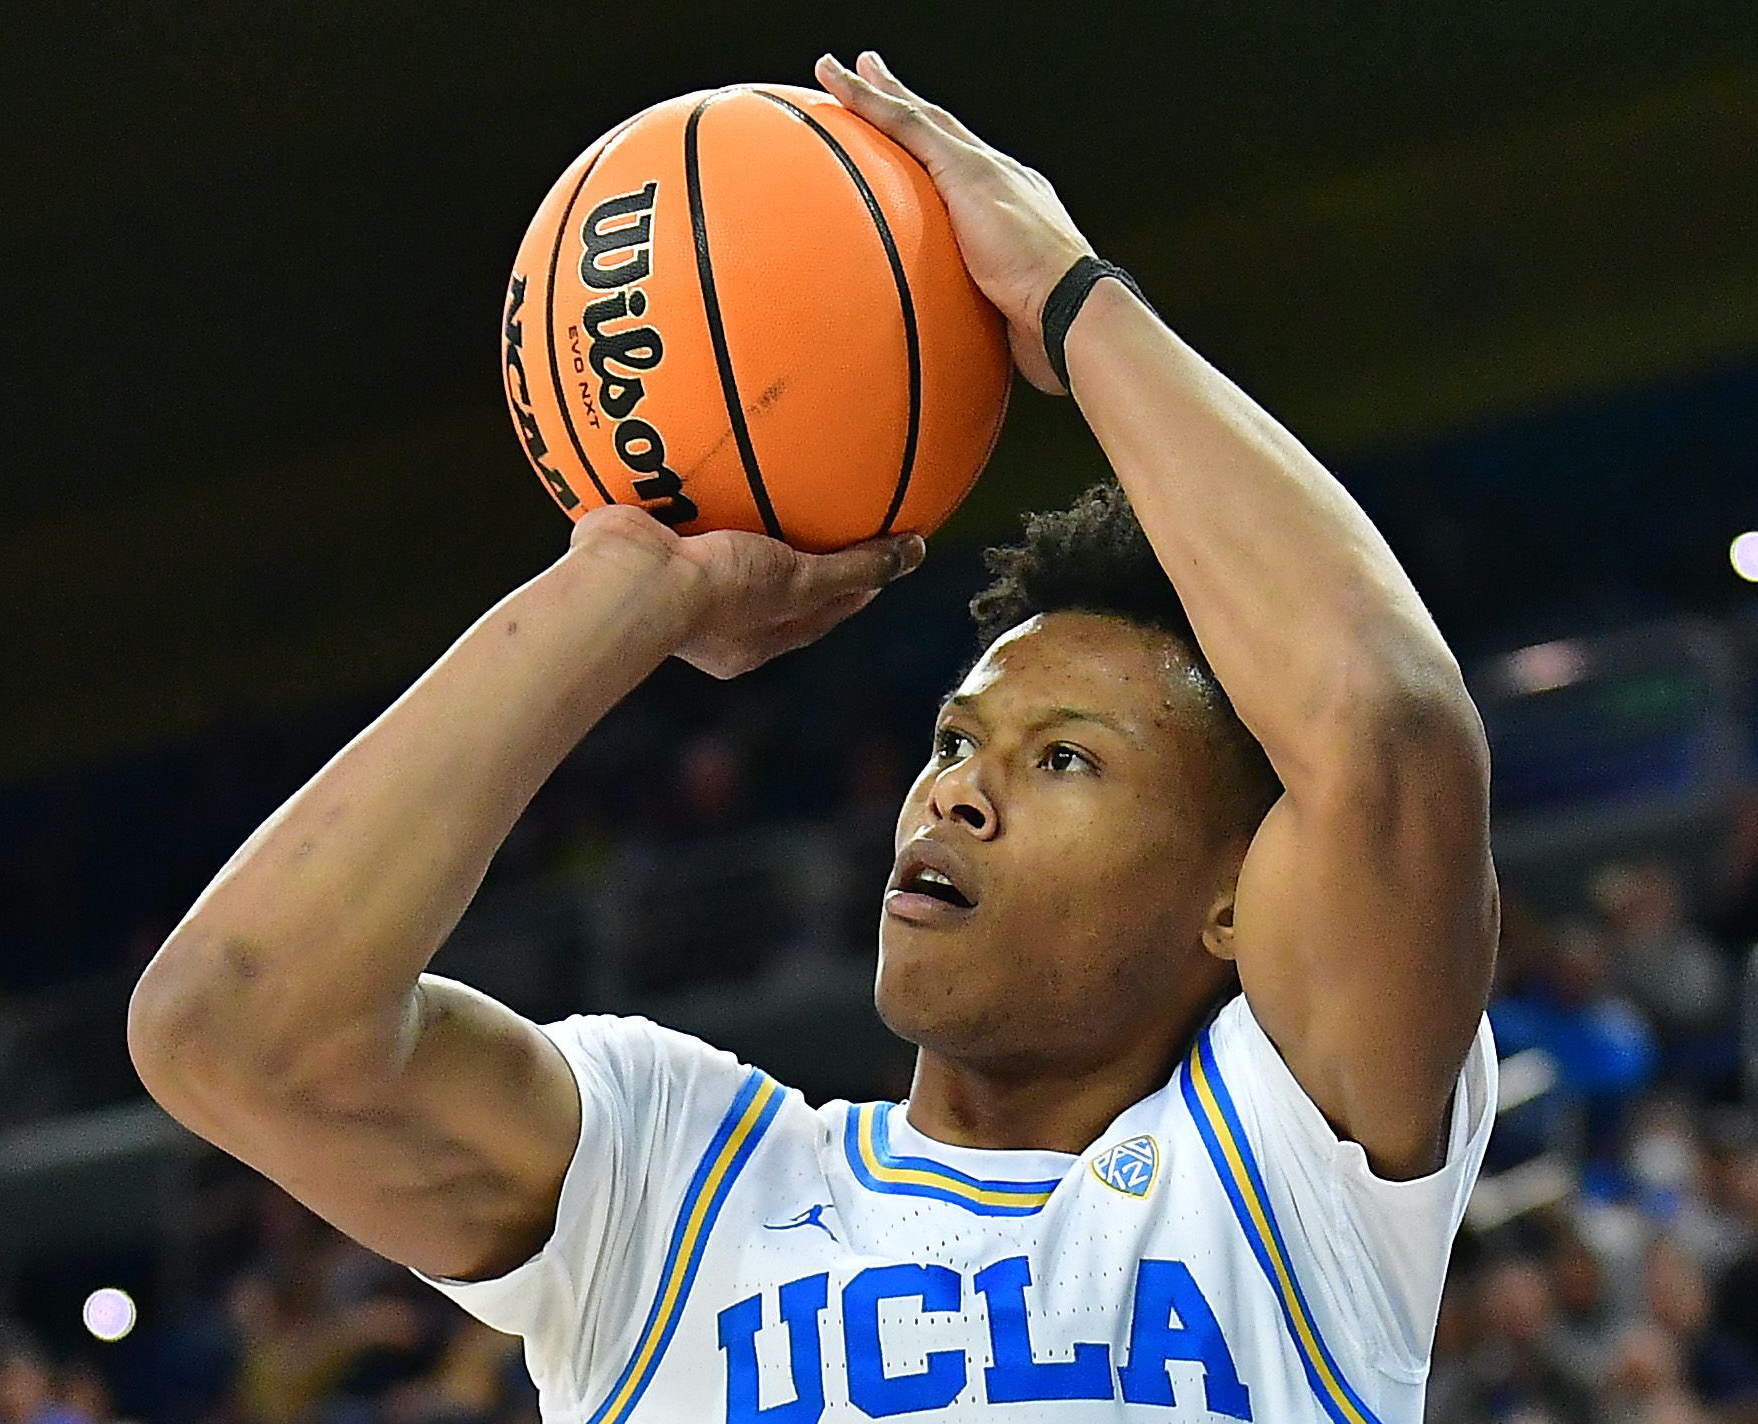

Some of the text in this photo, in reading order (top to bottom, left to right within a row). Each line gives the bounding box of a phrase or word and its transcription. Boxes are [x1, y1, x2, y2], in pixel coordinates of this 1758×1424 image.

[505, 273, 580, 510] NCAA
[568, 325, 600, 429] EVO NXT
[578, 180, 699, 527] Wilson
